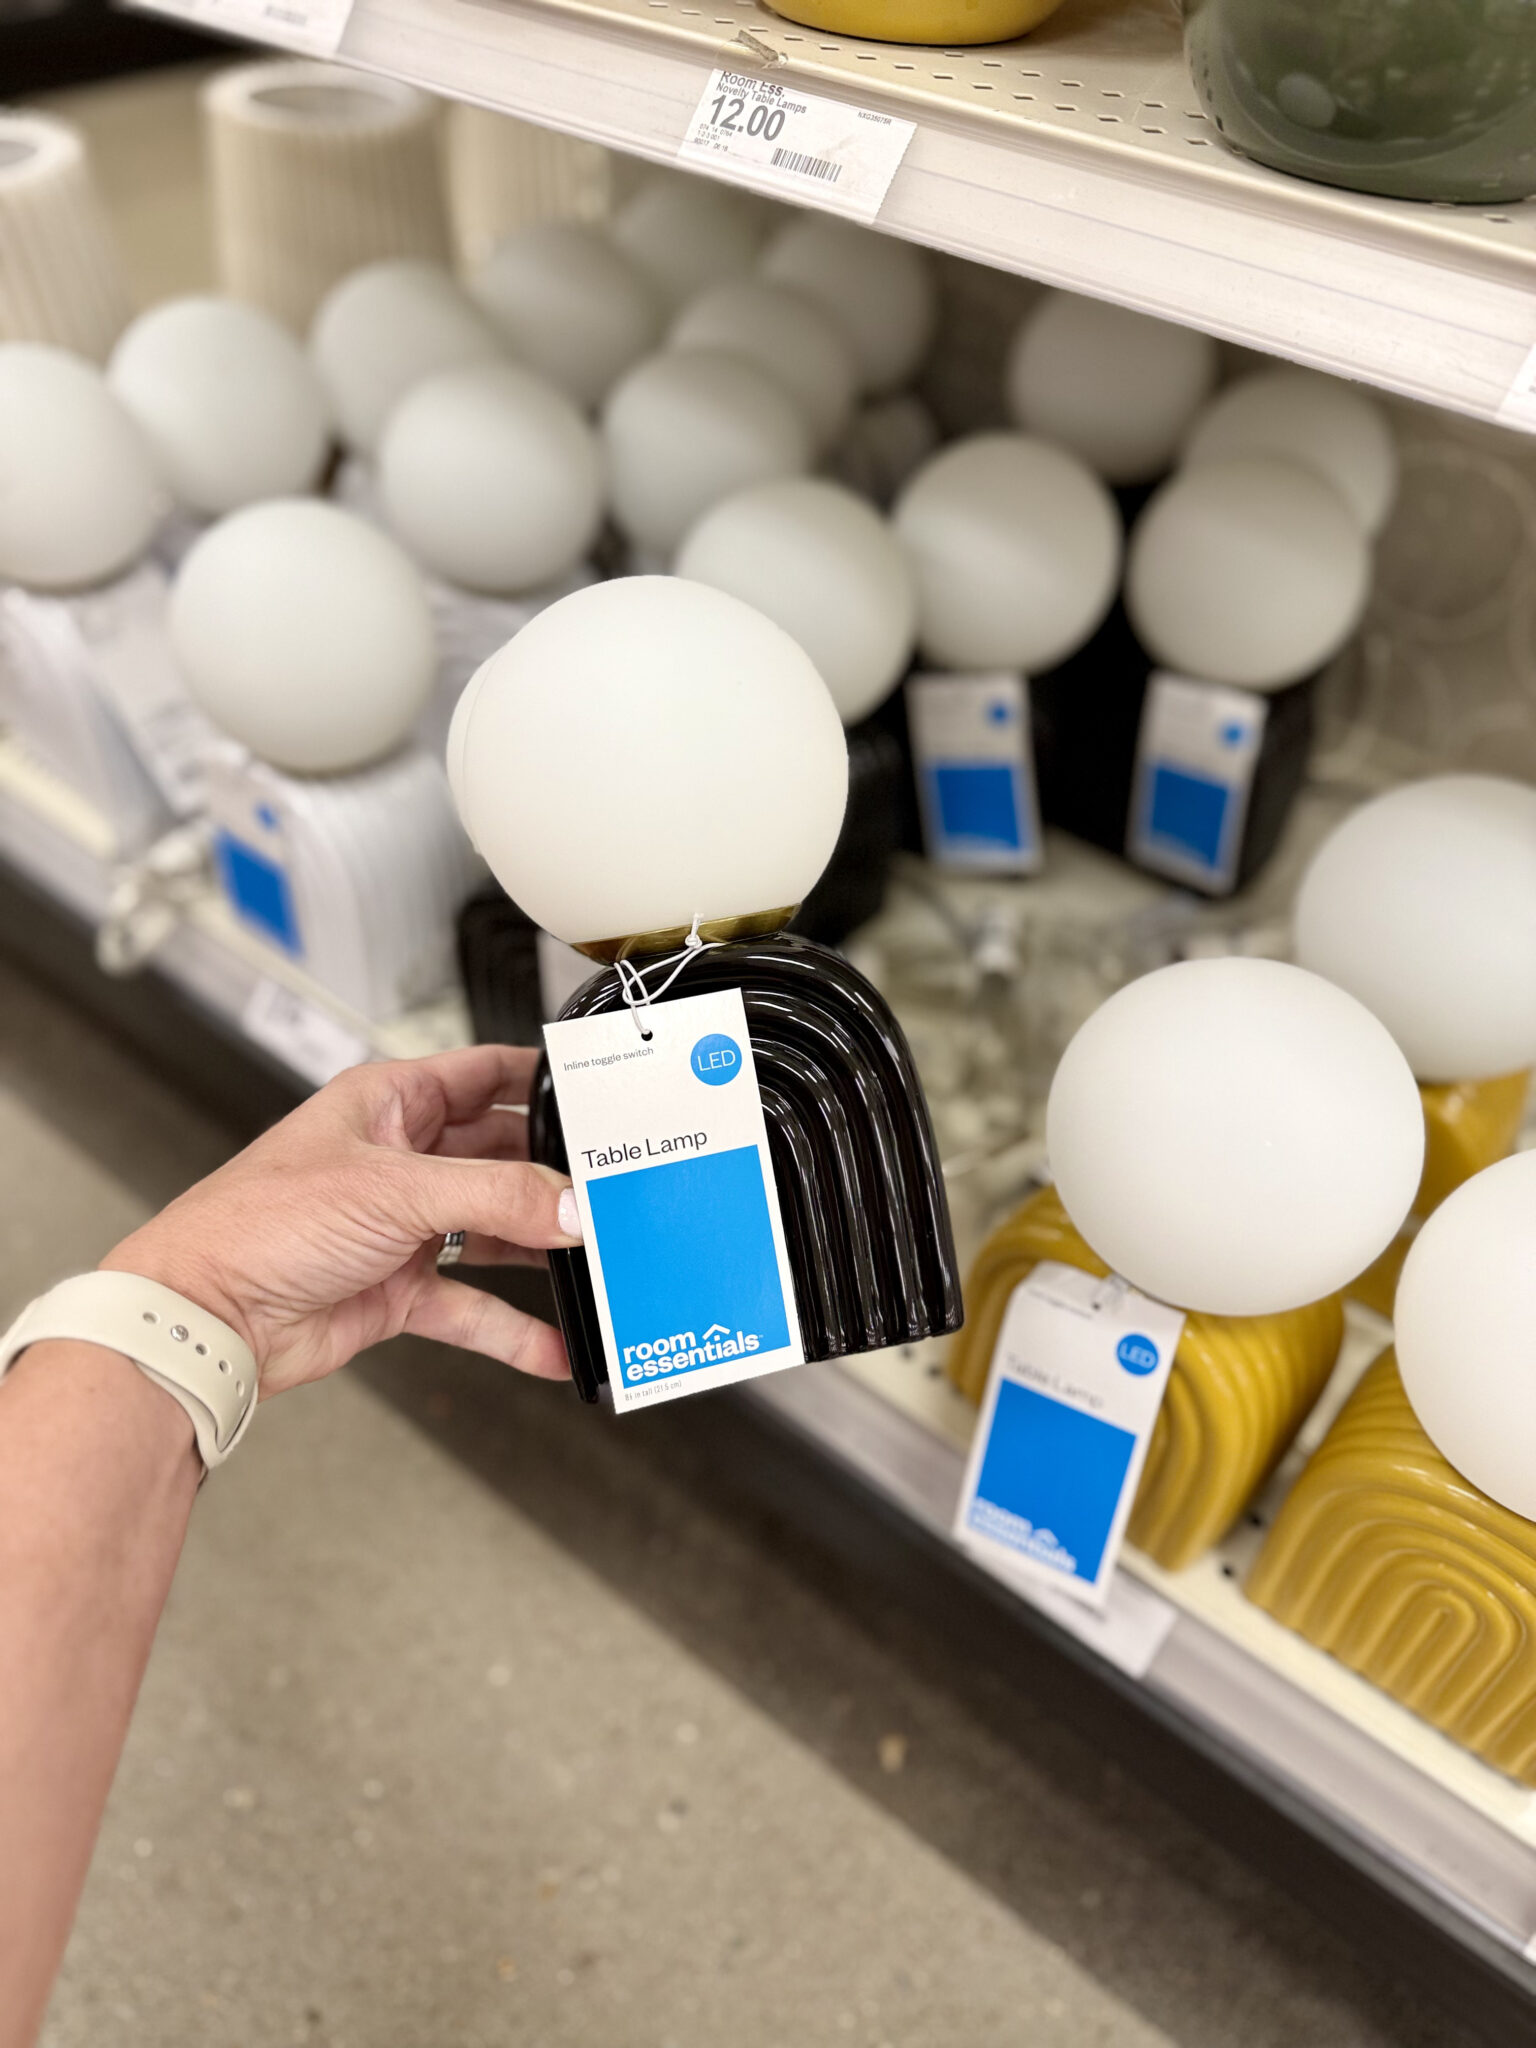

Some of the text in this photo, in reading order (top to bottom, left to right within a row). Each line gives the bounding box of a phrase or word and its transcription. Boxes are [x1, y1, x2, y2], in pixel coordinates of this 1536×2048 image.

[716, 82, 807, 114] Novelty Table Lamps
[720, 71, 785, 98] Room Ess.
[710, 94, 786, 142] 12.00
[563, 1046, 654, 1072] Inline toggle switch
[697, 1049, 736, 1072] LED
[581, 1131, 708, 1169] Table Lamp
[623, 1331, 697, 1364] room
[626, 1330, 760, 1382] essentials
[1119, 1343, 1157, 1370] LED
